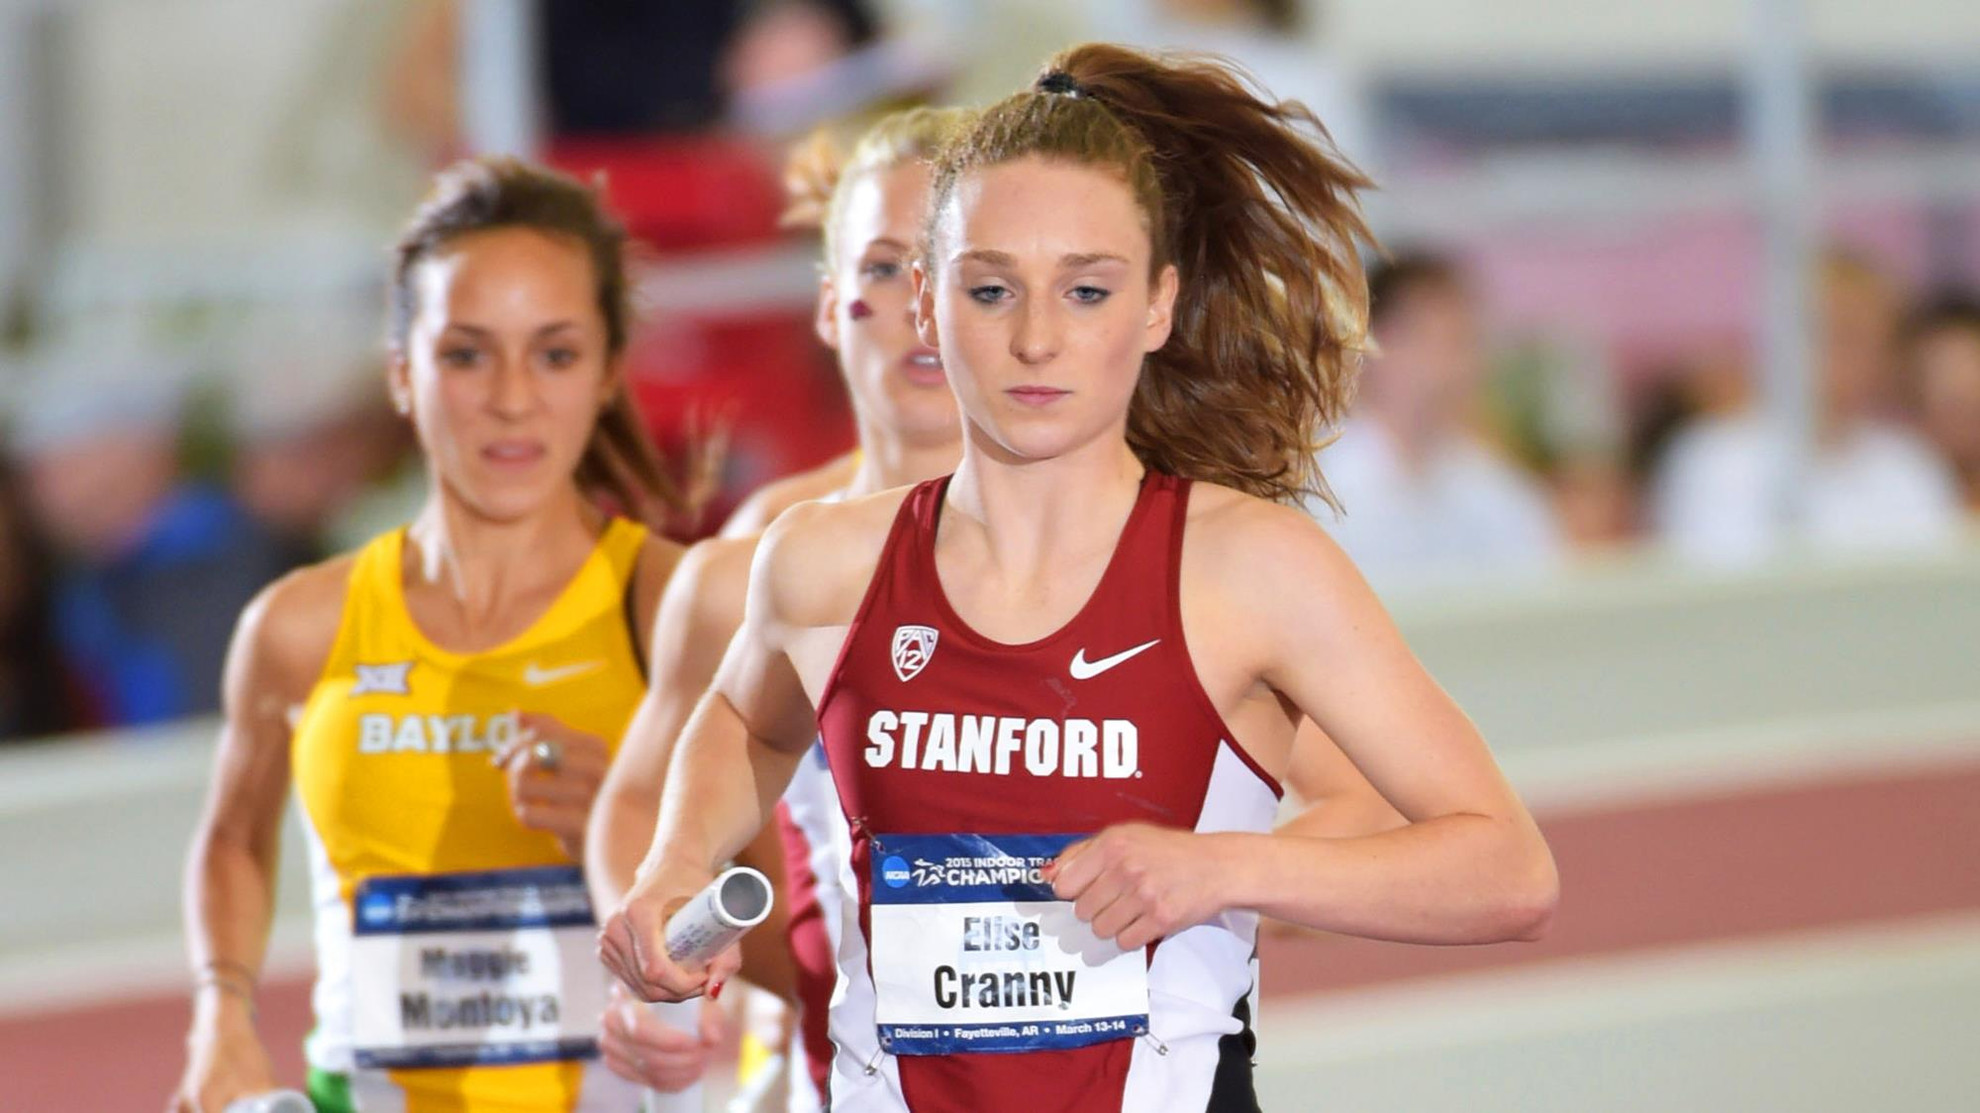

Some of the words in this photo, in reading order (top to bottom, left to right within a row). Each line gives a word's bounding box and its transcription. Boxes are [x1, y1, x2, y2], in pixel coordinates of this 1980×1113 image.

[359, 714, 518, 753] BAYLO
[865, 710, 1138, 779] STANFORD
[945, 857, 972, 868] 2015
[974, 856, 1026, 868] INDOOR
[946, 868, 1045, 886] CHAMPIO
[963, 916, 1040, 951] Elise
[933, 965, 1076, 1010] Cranny
[895, 1028, 933, 1039] Division
[954, 1026, 1020, 1039] Fayetteville,
[1021, 1024, 1039, 1036] AR
[1055, 1022, 1092, 1034] March
[1095, 1020, 1126, 1032] 13-14
